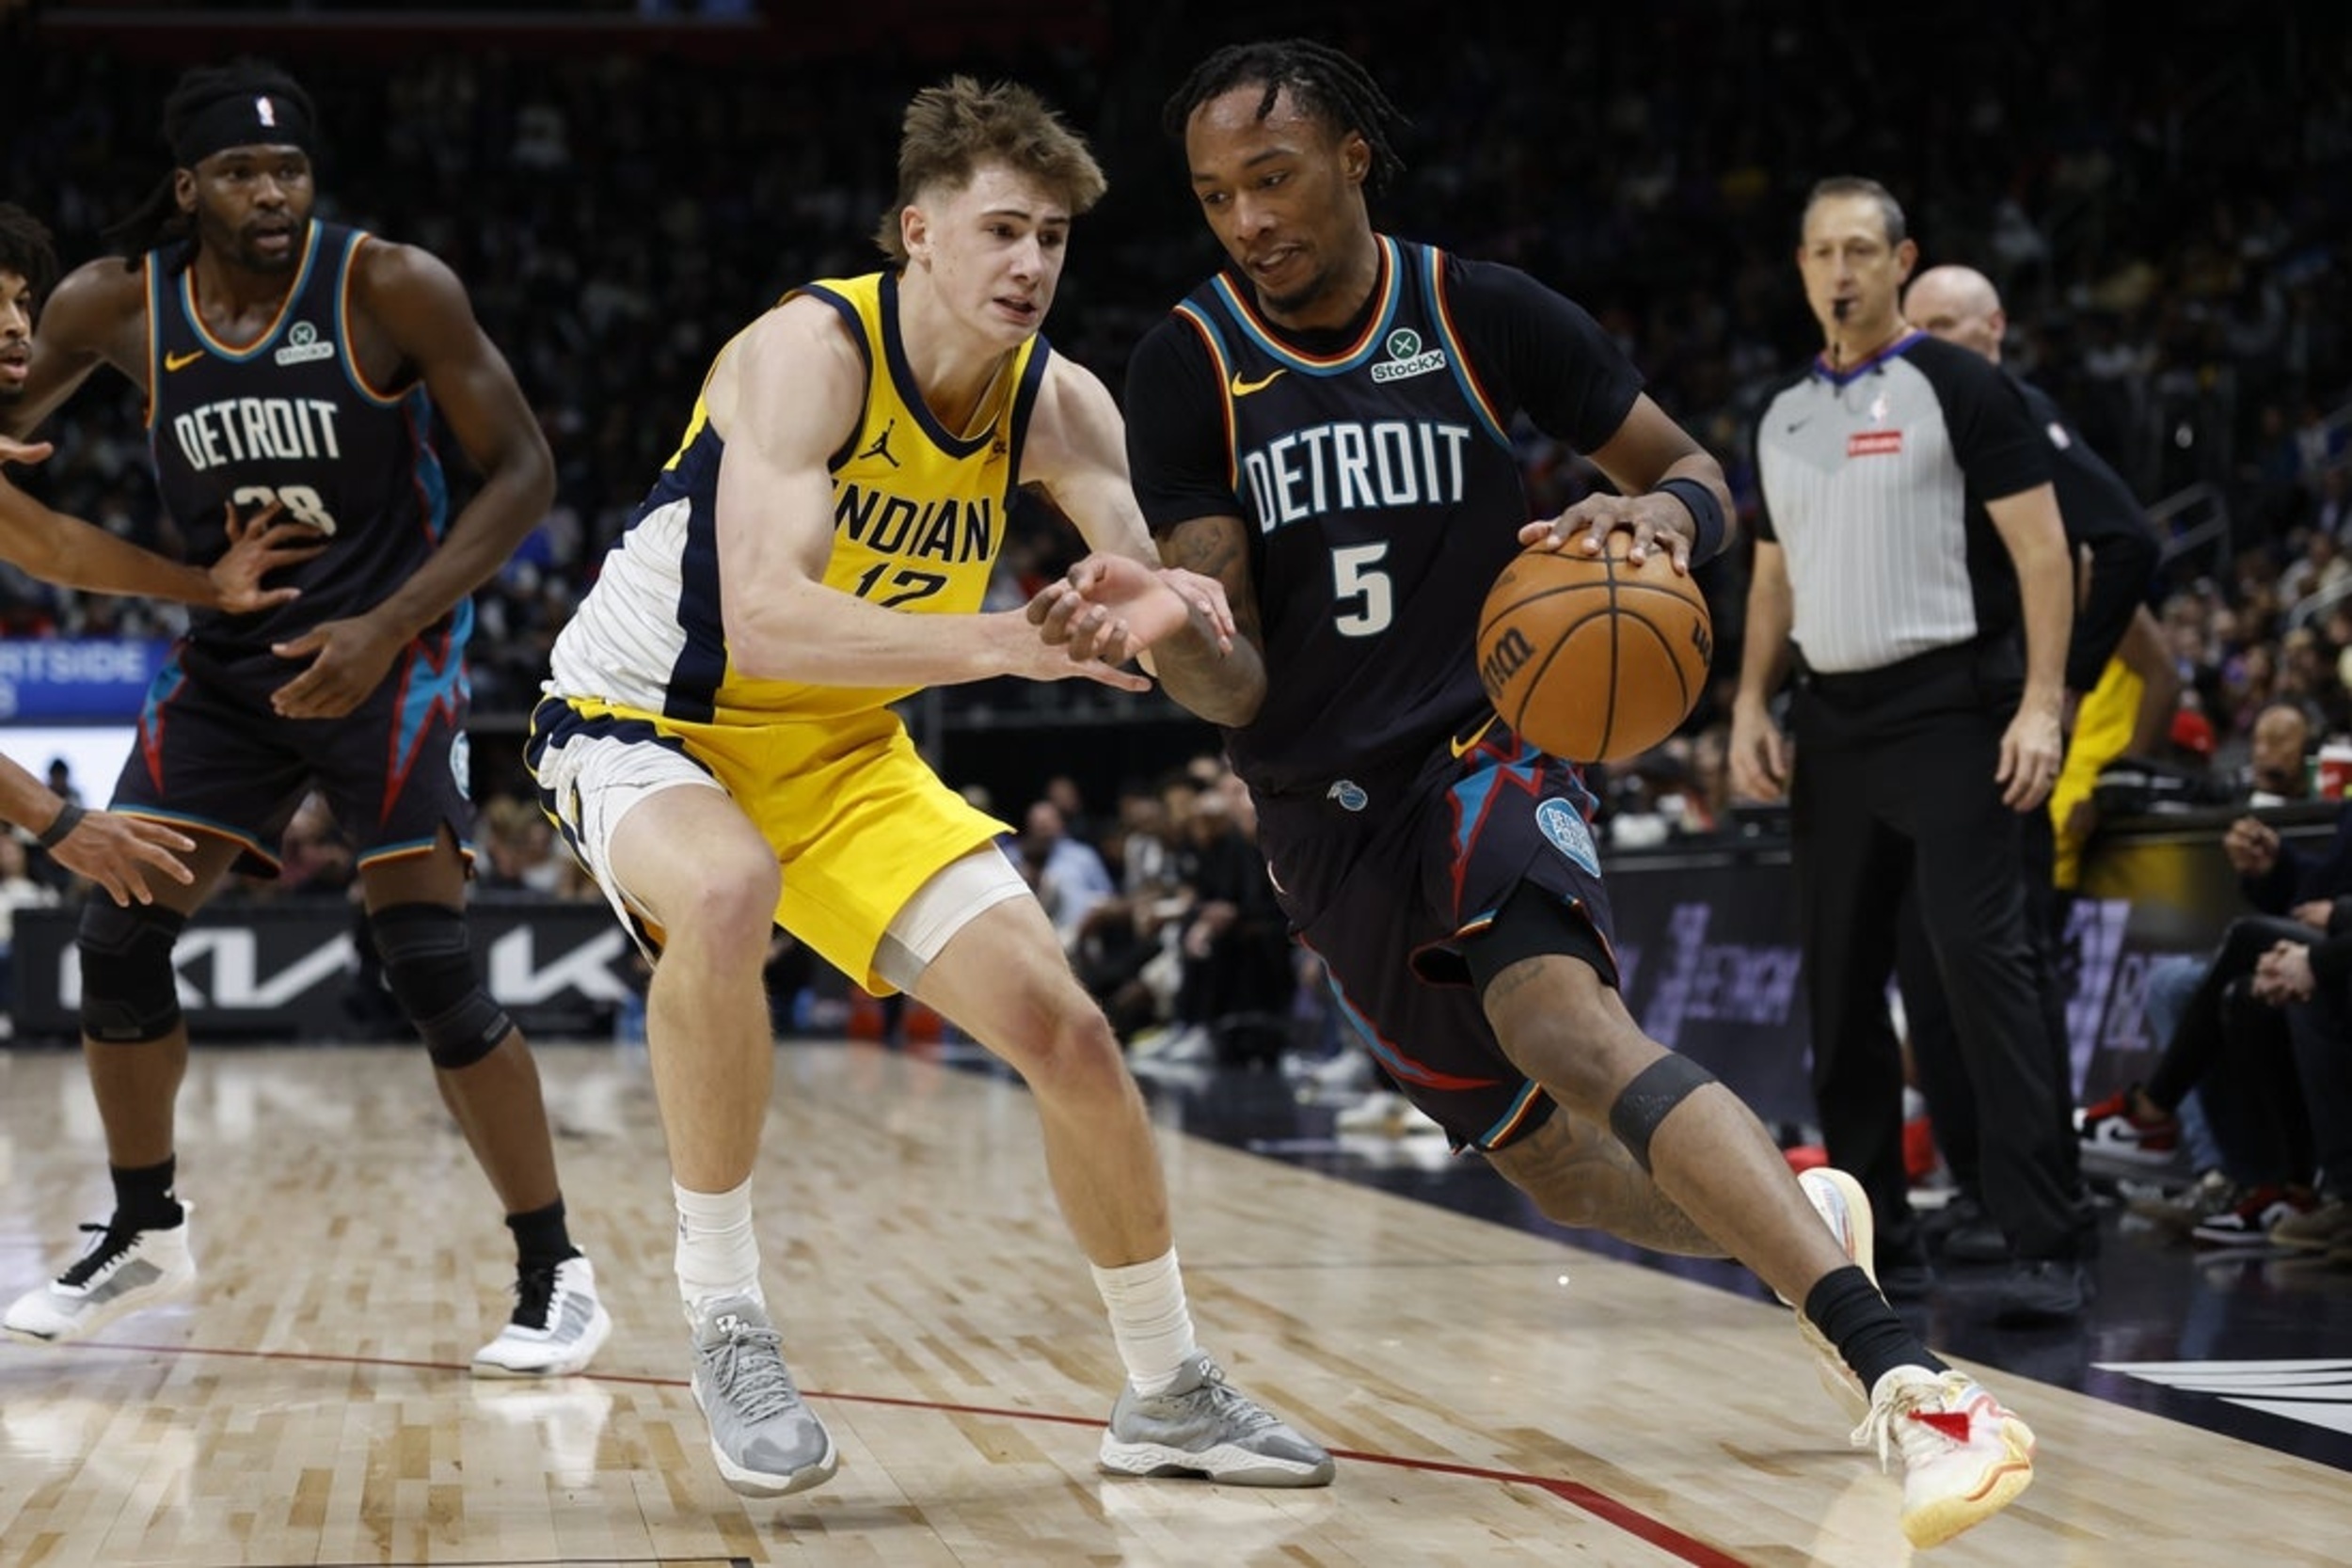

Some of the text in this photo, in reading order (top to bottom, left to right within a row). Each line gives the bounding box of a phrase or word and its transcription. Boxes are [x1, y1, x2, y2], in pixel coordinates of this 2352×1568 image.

[1374, 352, 1444, 379] StockX
[174, 396, 341, 470] DETROIT
[1244, 421, 1470, 534] DETROIT
[832, 478, 996, 563] NDIAN
[1331, 542, 1392, 636] 5
